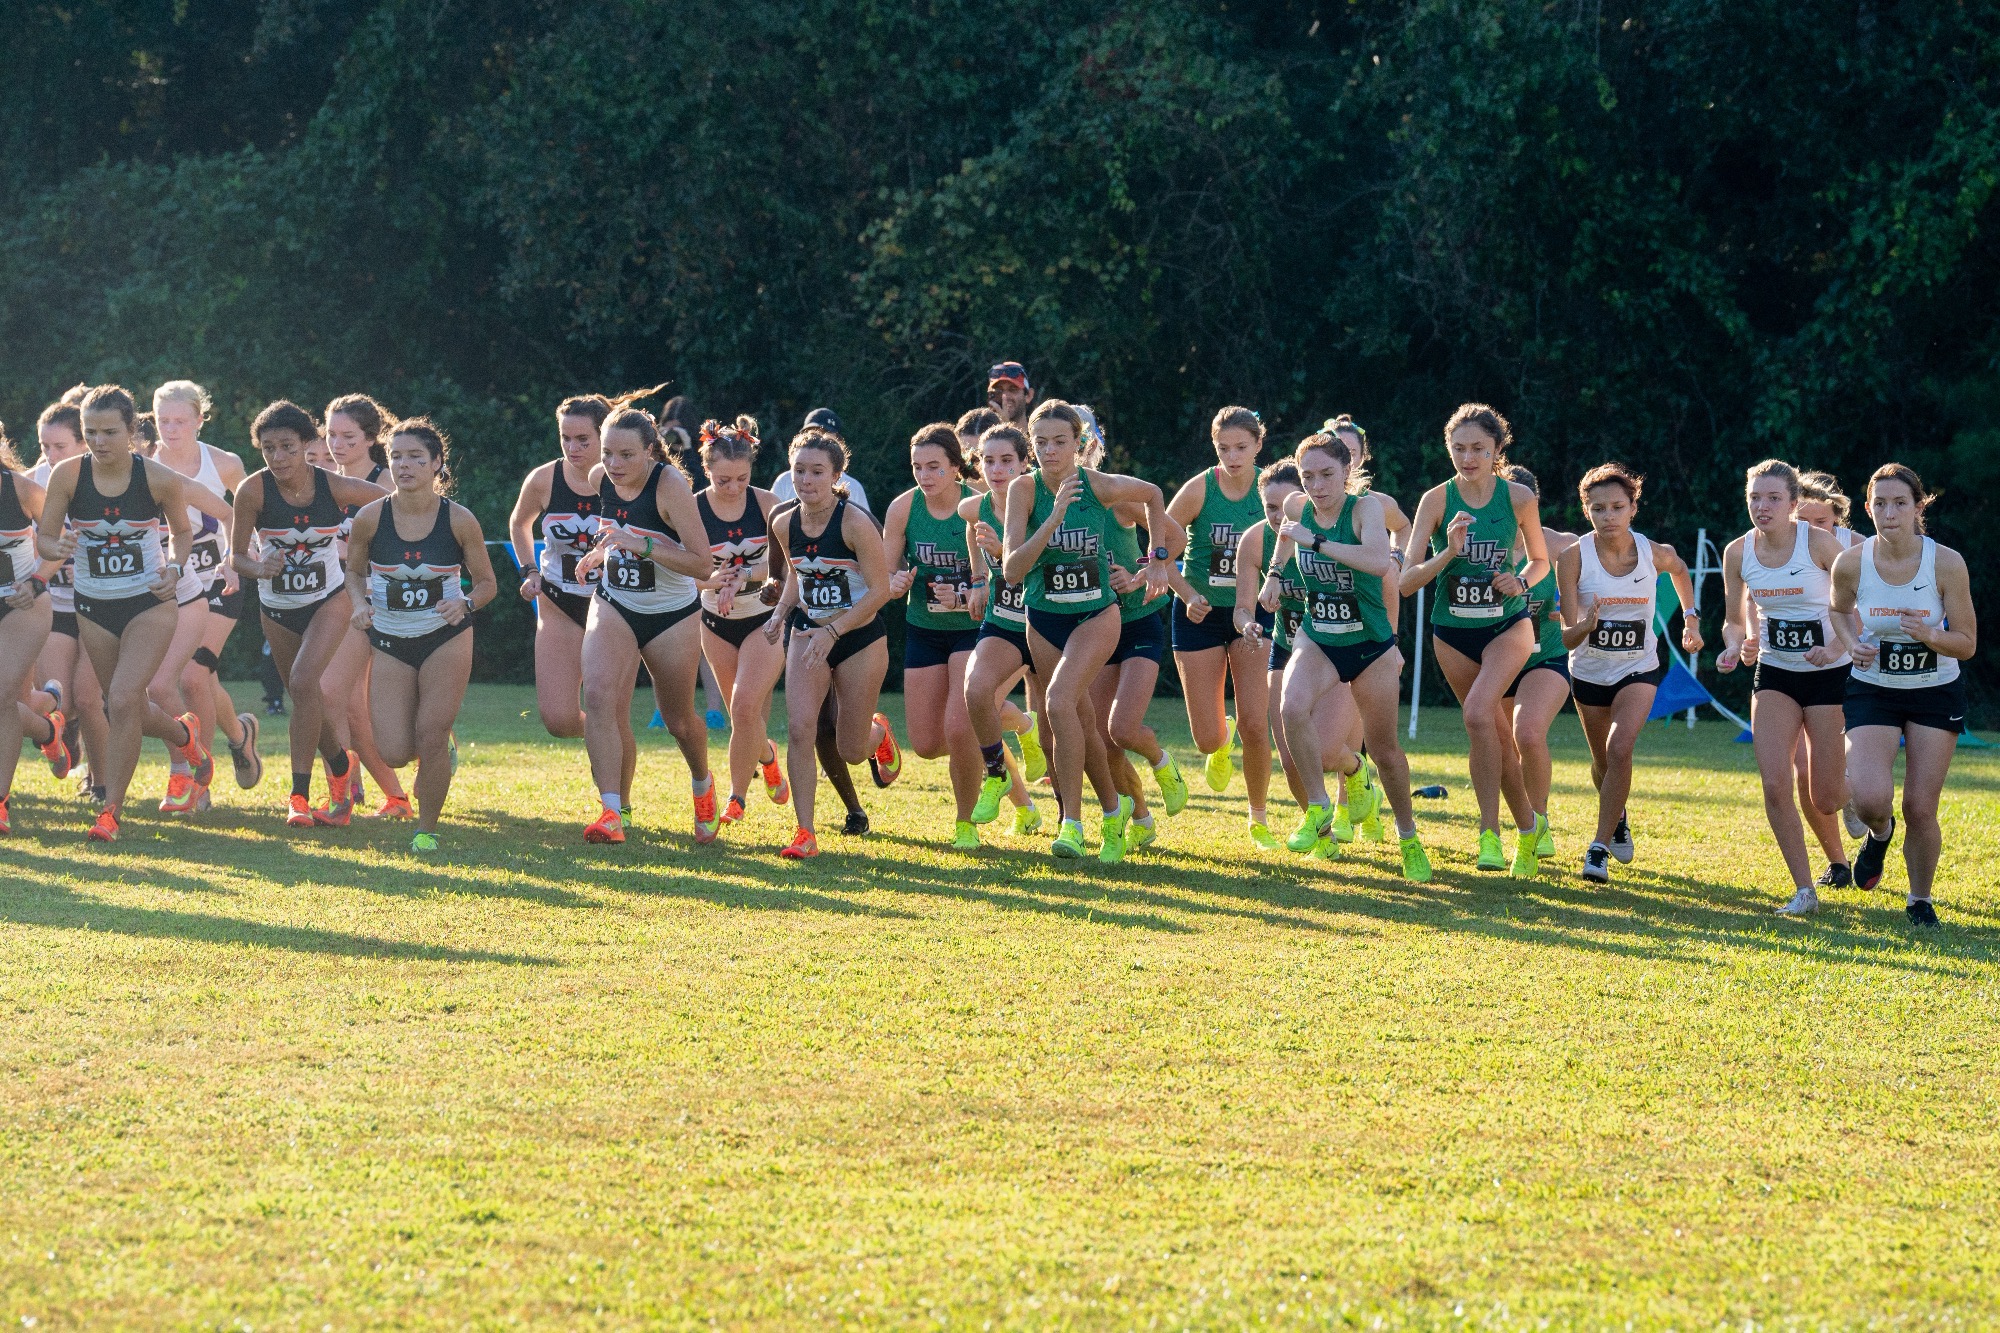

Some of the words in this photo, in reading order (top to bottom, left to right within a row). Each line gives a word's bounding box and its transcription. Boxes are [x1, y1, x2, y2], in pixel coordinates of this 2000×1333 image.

[1209, 522, 1243, 550] UW
[97, 554, 135, 574] 102
[187, 550, 213, 570] 86
[282, 571, 319, 591] 104
[617, 567, 640, 587] 93
[1052, 571, 1089, 590] 991
[1299, 550, 1355, 593] UWF
[402, 588, 429, 608] 99
[812, 585, 842, 605] 103
[1002, 589, 1024, 609] 98
[1456, 585, 1494, 603] 984
[1315, 601, 1351, 620] 988
[1597, 630, 1637, 647] 909
[1776, 629, 1815, 648] 834
[1888, 651, 1930, 670] 897
